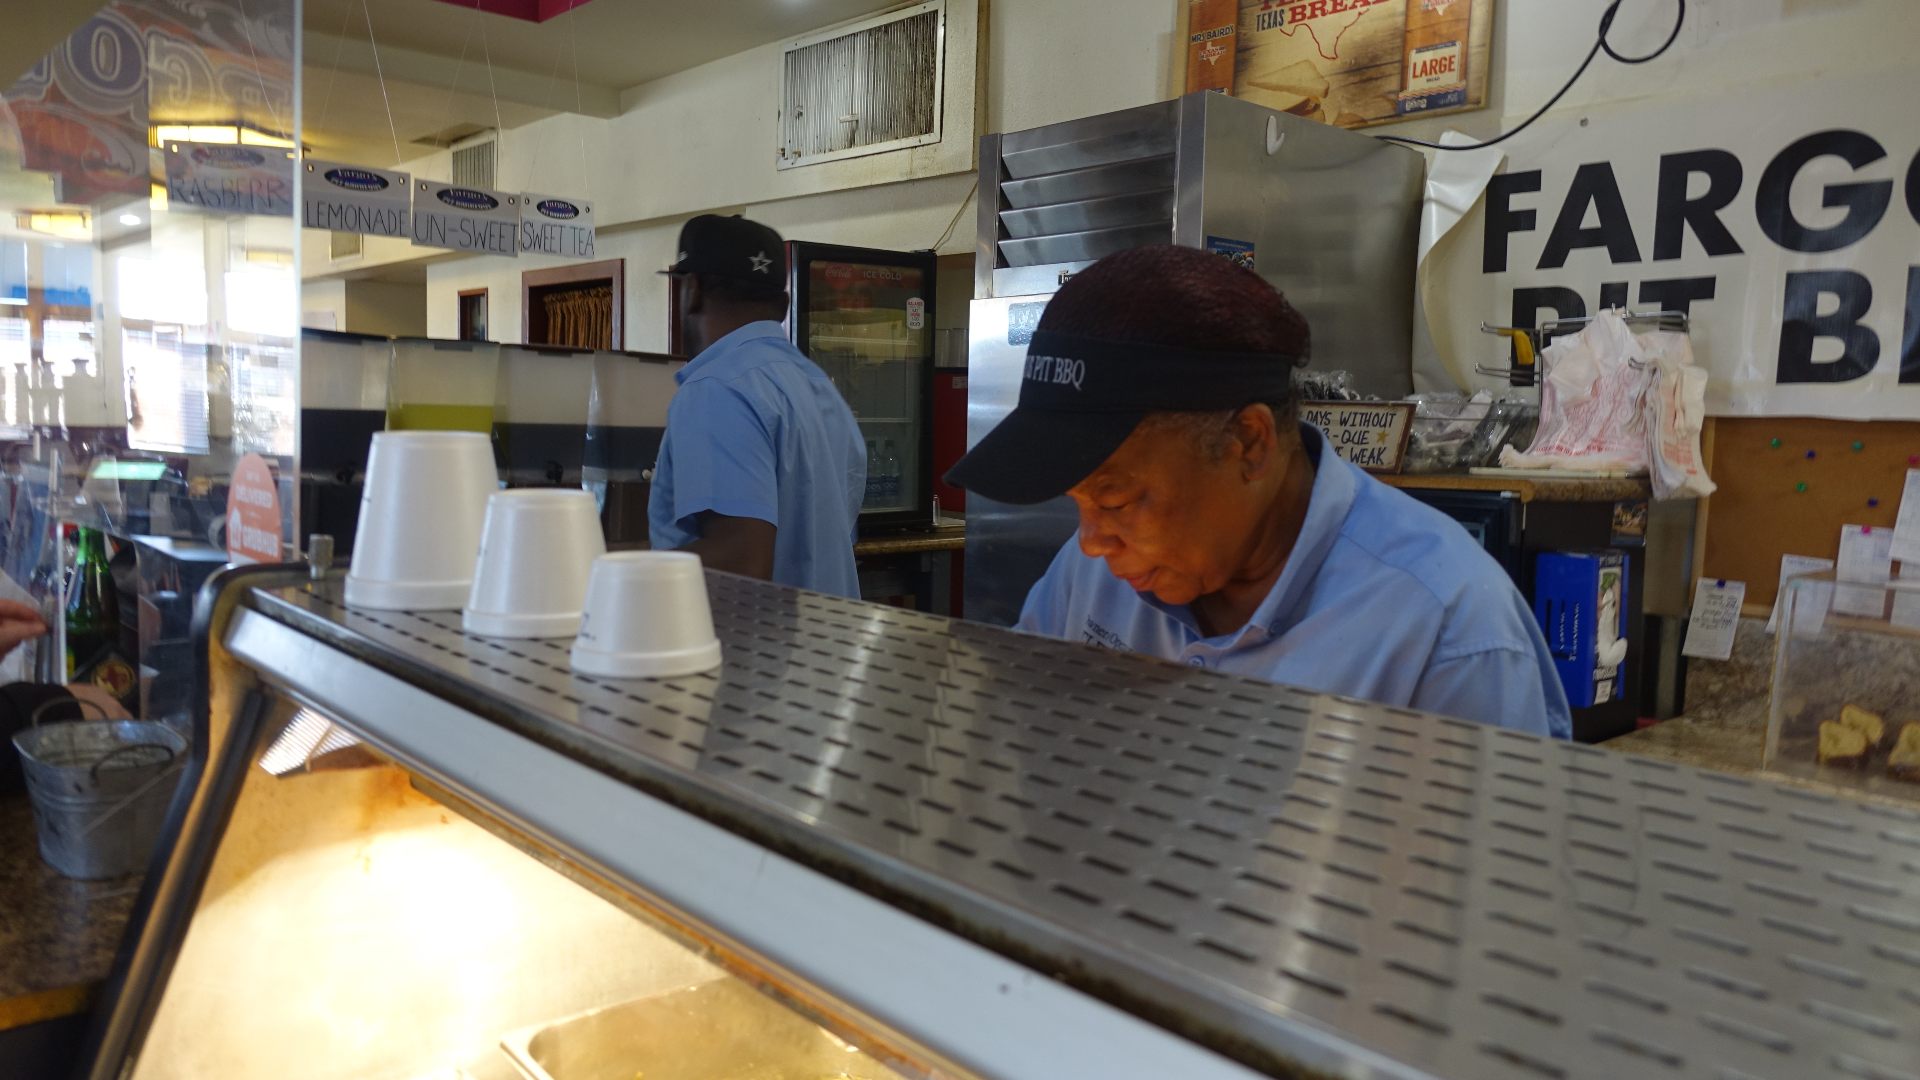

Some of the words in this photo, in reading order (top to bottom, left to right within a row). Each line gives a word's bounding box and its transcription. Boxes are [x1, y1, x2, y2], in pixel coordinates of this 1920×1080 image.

[1256, 9, 1285, 32] TEXAS
[1288, 0, 1391, 24] BREA
[1191, 33, 1205, 43] MRS
[1206, 24, 1235, 40] BAIRD'S
[1412, 54, 1456, 79] LARGE
[1482, 128, 1920, 274] FARG
[306, 200, 409, 237] LEMONADE
[413, 213, 519, 253] UN-SWEET
[522, 221, 566, 254] SWEET
[570, 225, 595, 256] TEA
[825, 265, 852, 278] Coca-Cola
[863, 271, 877, 279] ICE
[879, 271, 902, 281] COLD
[1032, 356, 1054, 382] PIT
[1053, 357, 1085, 391] BBQ
[1306, 411, 1332, 426] DAYS
[1340, 411, 1396, 428] WITHOUT
[1350, 447, 1387, 465] WEAK
